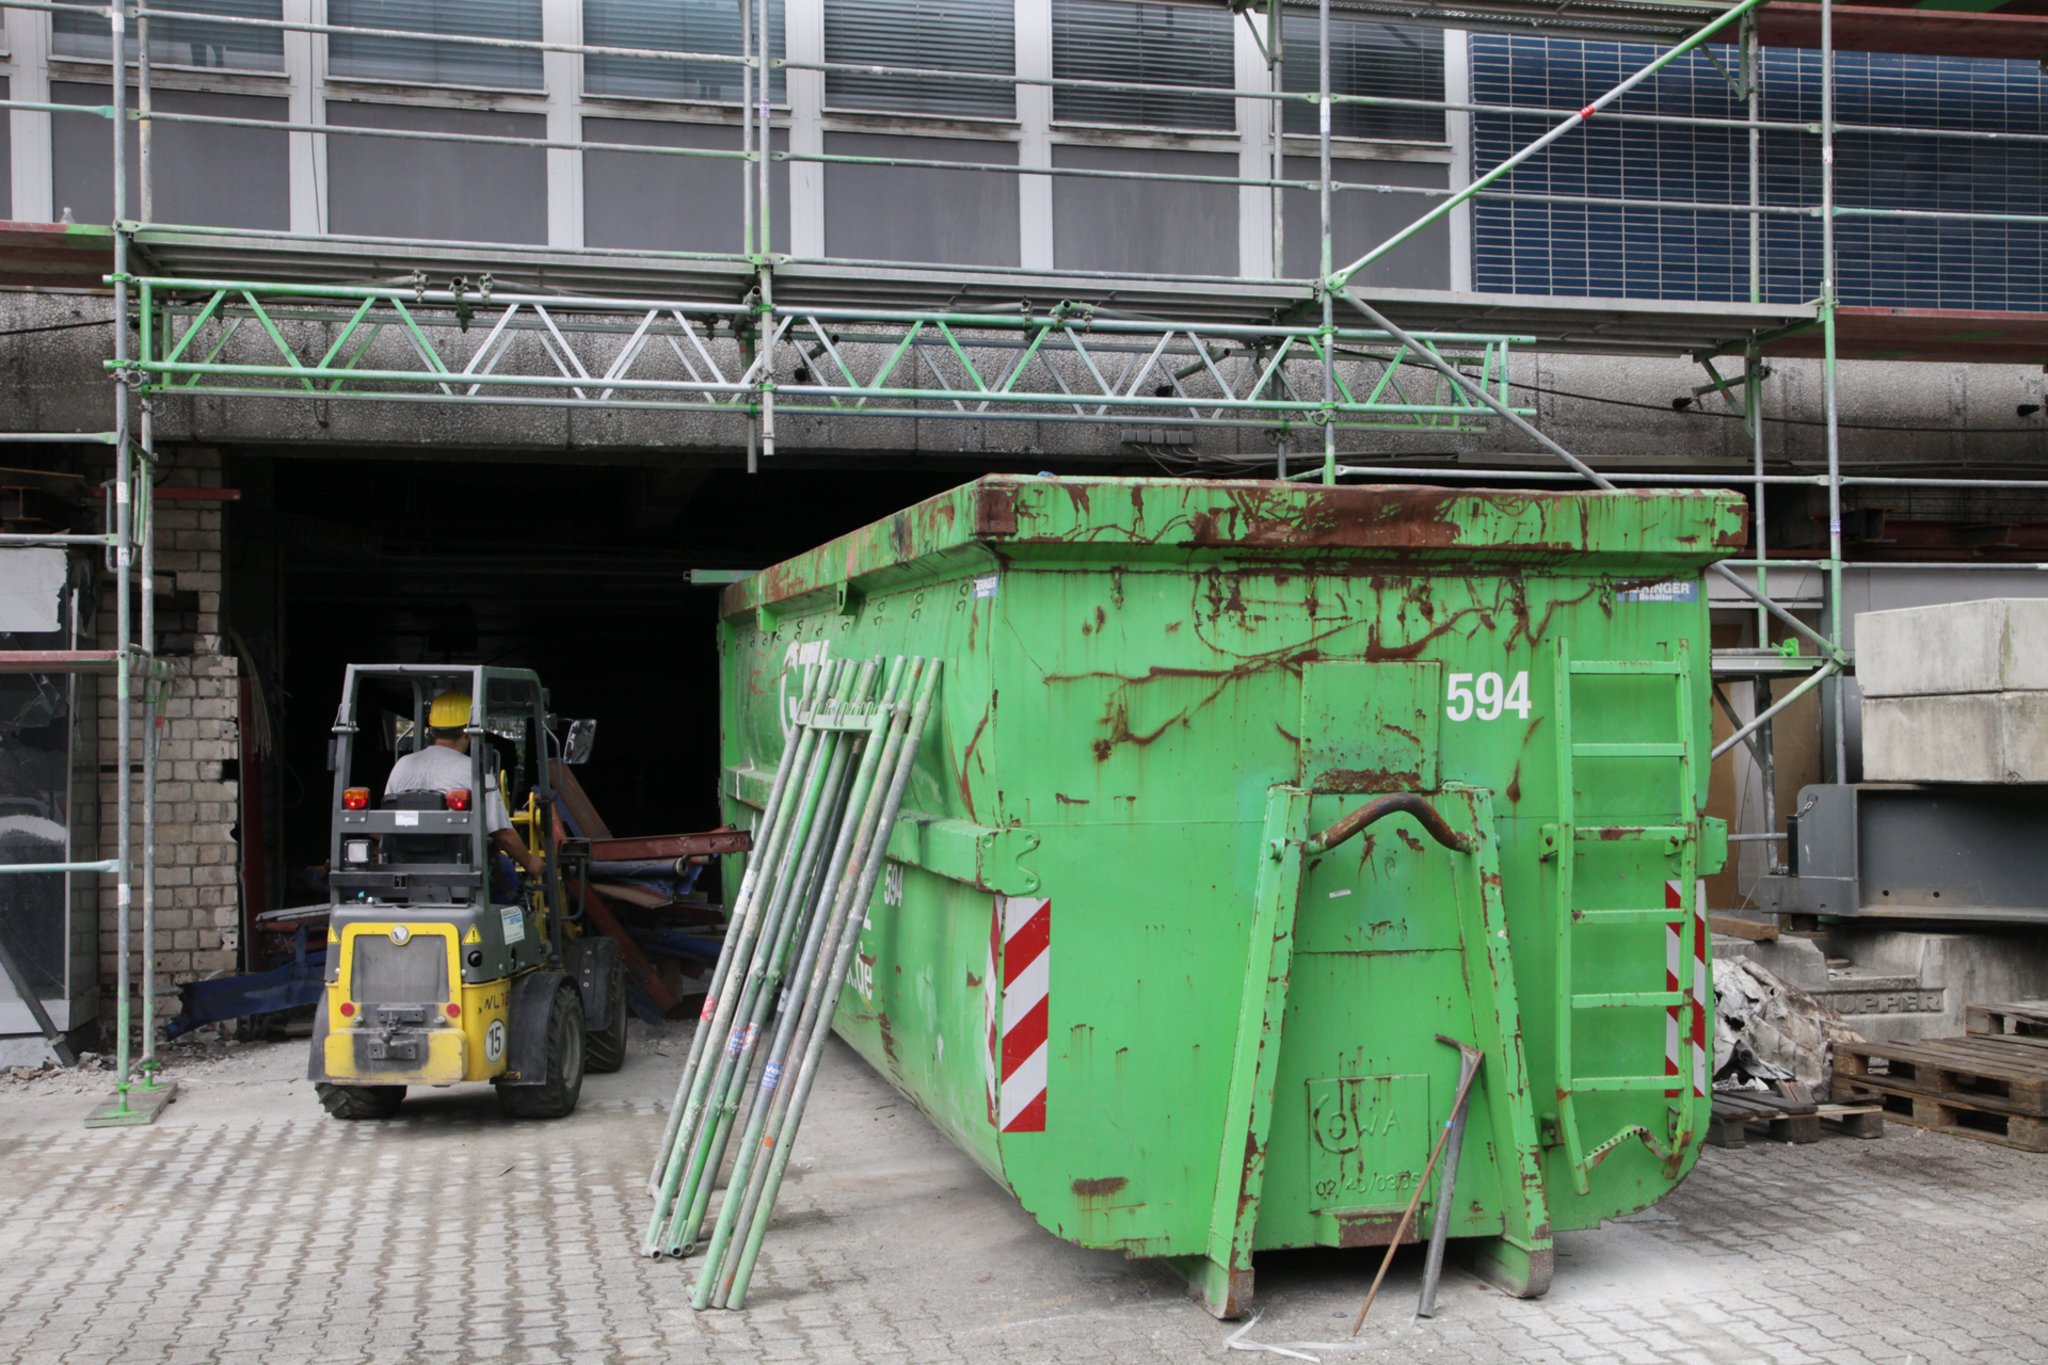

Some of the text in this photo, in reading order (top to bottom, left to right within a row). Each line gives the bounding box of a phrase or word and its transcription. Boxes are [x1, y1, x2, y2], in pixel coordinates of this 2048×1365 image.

[1446, 671, 1532, 721] 594
[884, 864, 904, 907] 594
[1826, 991, 1942, 1014] UPPER
[488, 1026, 502, 1057] 15
